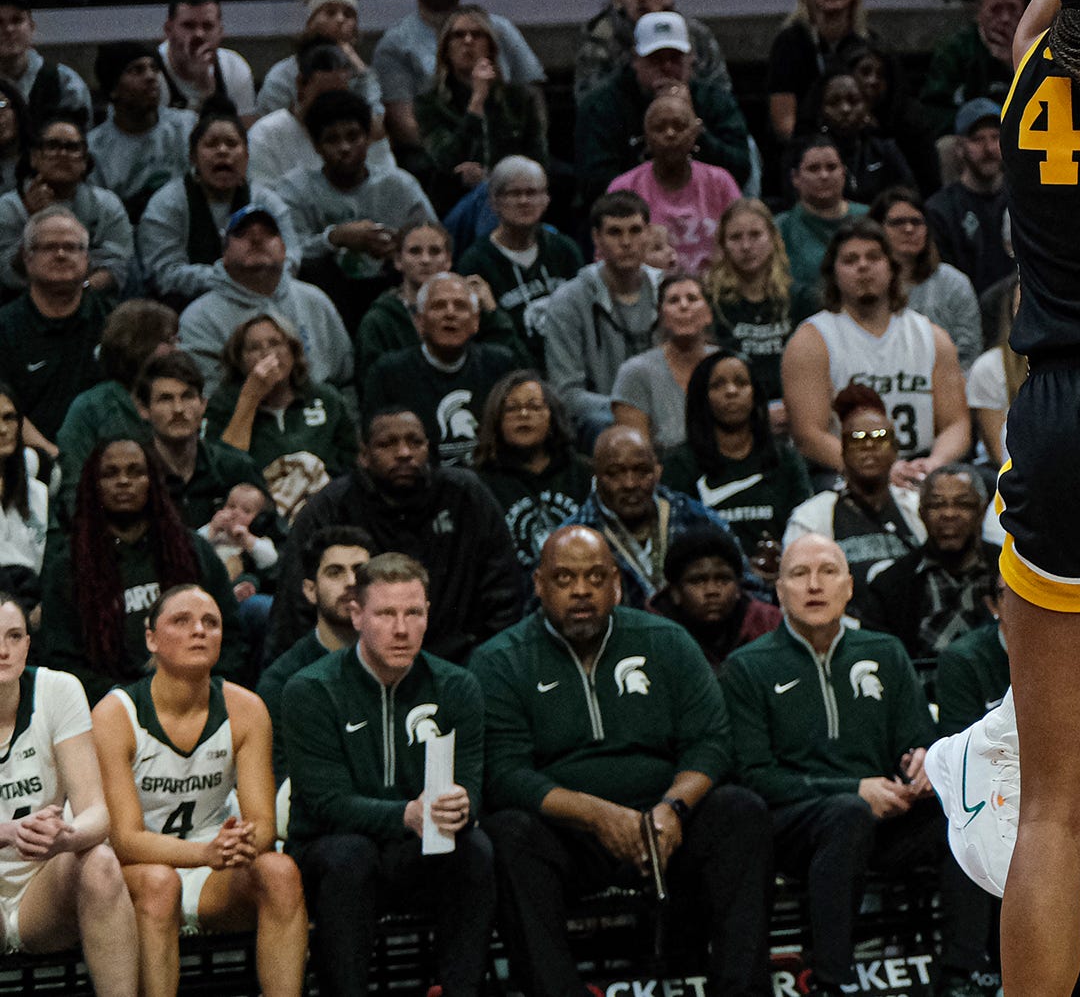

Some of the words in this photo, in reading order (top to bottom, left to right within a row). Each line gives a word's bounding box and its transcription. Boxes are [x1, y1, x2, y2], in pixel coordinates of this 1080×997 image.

[893, 404, 917, 451] 3
[141, 771, 223, 794] SPARTANS
[162, 801, 197, 840] 4
[586, 976, 708, 997] CKET
[771, 954, 933, 997] RKET
